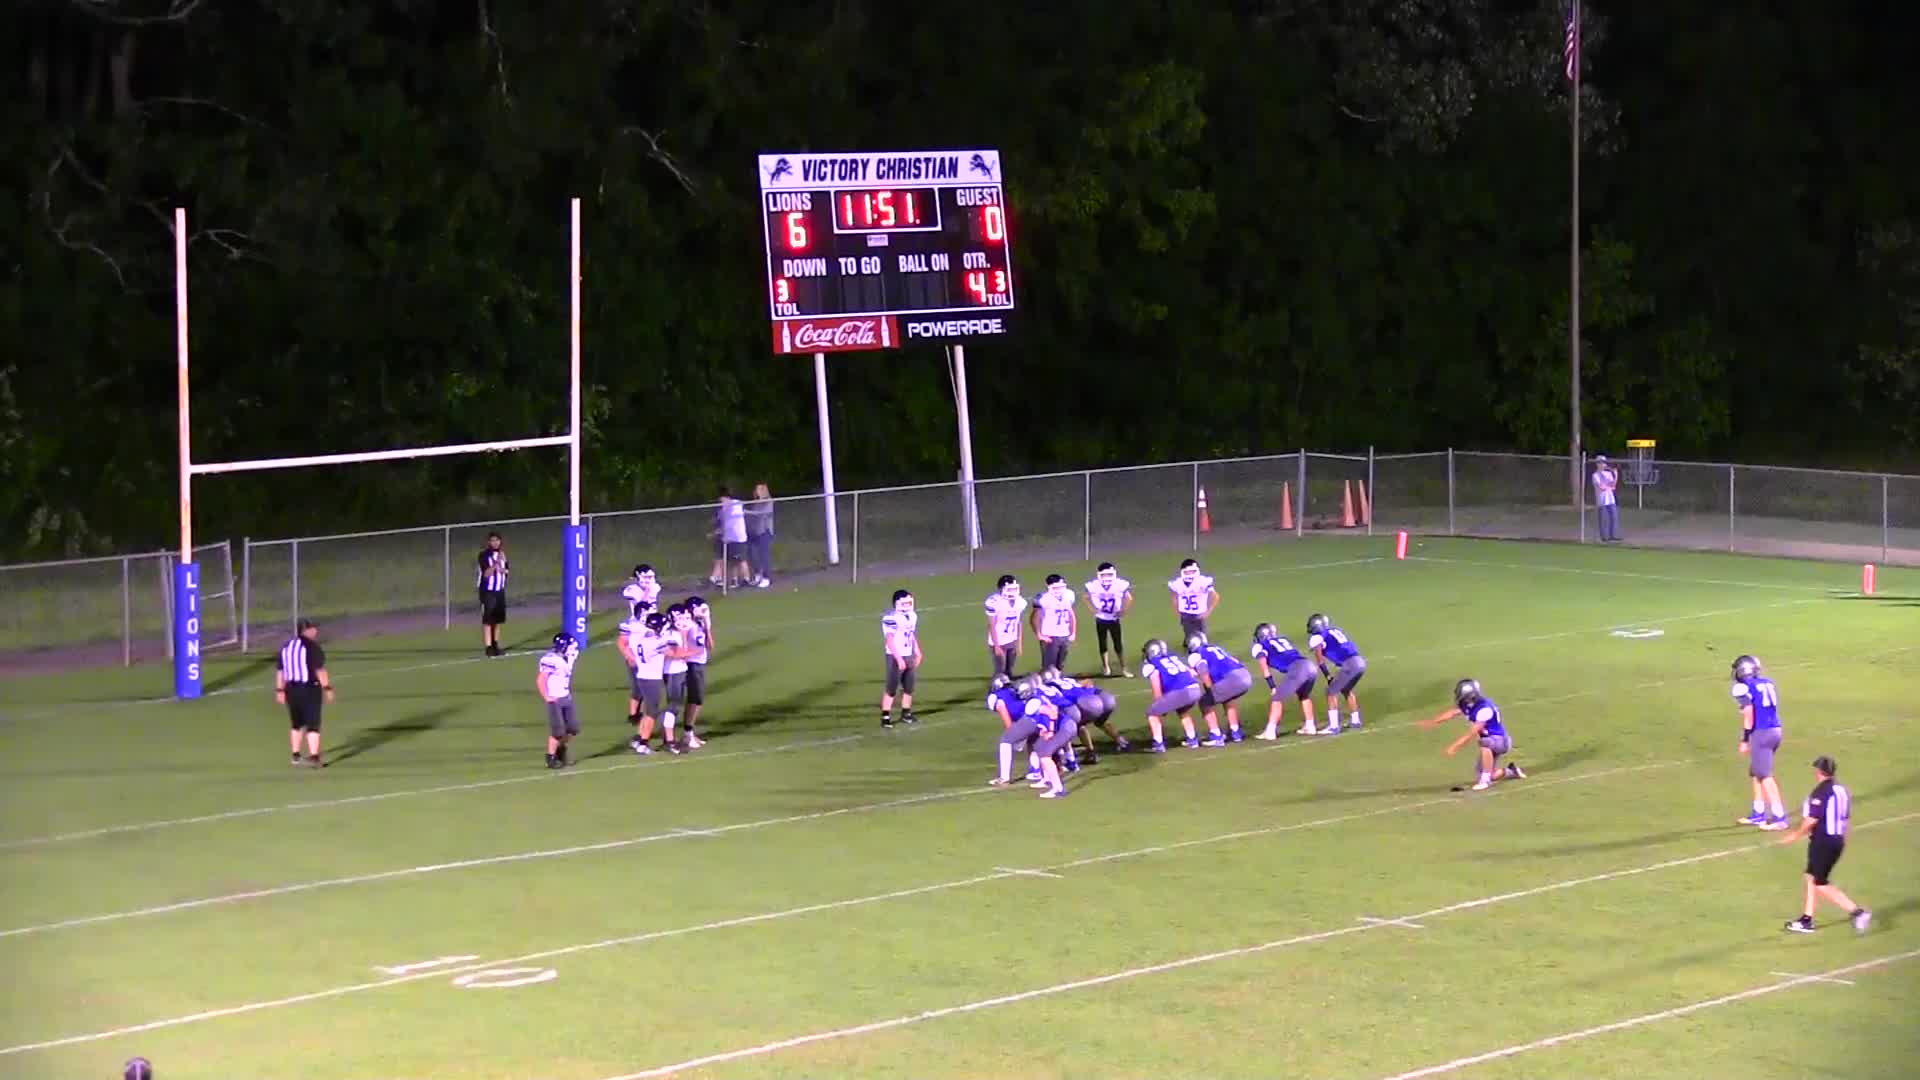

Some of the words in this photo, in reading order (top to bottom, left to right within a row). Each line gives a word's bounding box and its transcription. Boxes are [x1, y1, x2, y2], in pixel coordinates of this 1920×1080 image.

[802, 158, 870, 182] VICTORY
[876, 156, 959, 181] CHRISTIAN
[768, 192, 812, 212] LIONS
[956, 188, 999, 207] GUEST
[787, 212, 807, 248] 6
[984, 206, 1003, 240] 0
[783, 258, 827, 277] DOWN
[839, 257, 858, 275] TO
[861, 257, 881, 274] GO
[899, 254, 929, 272] BALL
[931, 253, 949, 271] ON
[776, 279, 789, 302] 3
[968, 272, 987, 303] 4
[995, 271, 1005, 292] 3
[987, 293, 1009, 305] TOL
[776, 303, 800, 316] TOL
[795, 321, 877, 348] Coca-Cola
[907, 319, 1002, 338] POWERADE
[576, 533, 586, 632] LIONS
[1181, 595, 1199, 611] 35
[186, 572, 199, 680] LIONS
